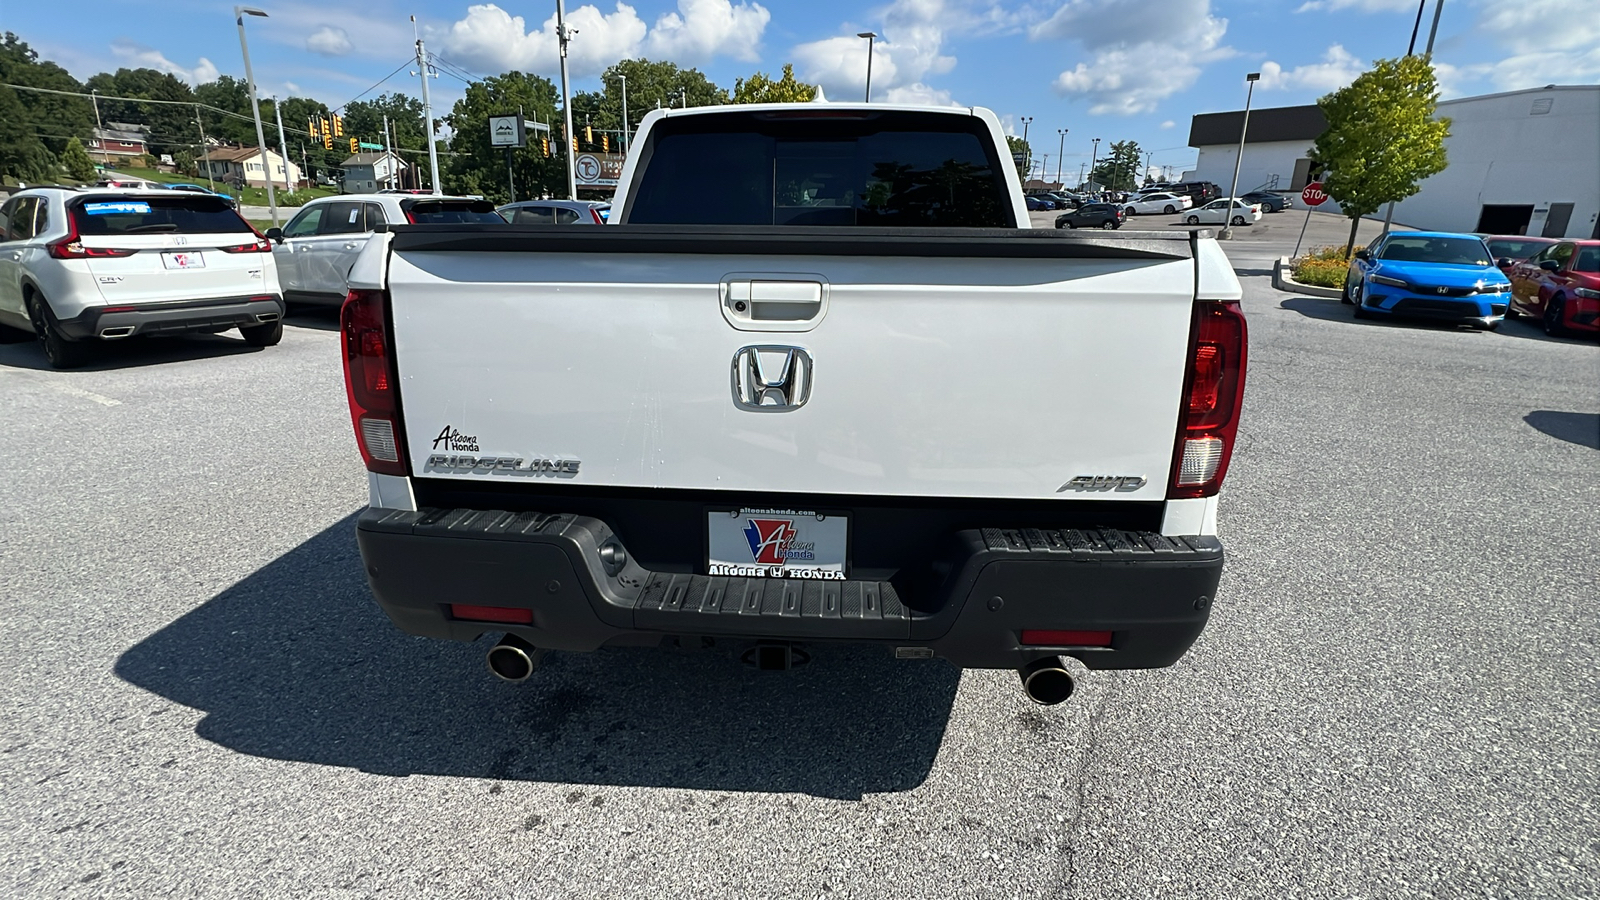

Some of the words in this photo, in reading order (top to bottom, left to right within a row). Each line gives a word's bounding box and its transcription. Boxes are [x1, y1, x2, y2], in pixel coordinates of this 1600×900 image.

[432, 425, 478, 451] Altoona
[452, 442, 480, 452] Honda
[424, 453, 582, 478] RIDGELINE
[1058, 474, 1148, 492] AWD
[740, 507, 816, 516] altoonahonda.com
[756, 524, 815, 559] Altoona
[779, 548, 815, 560] Honda
[708, 564, 765, 577] Altoona
[789, 568, 847, 580] HONDA
